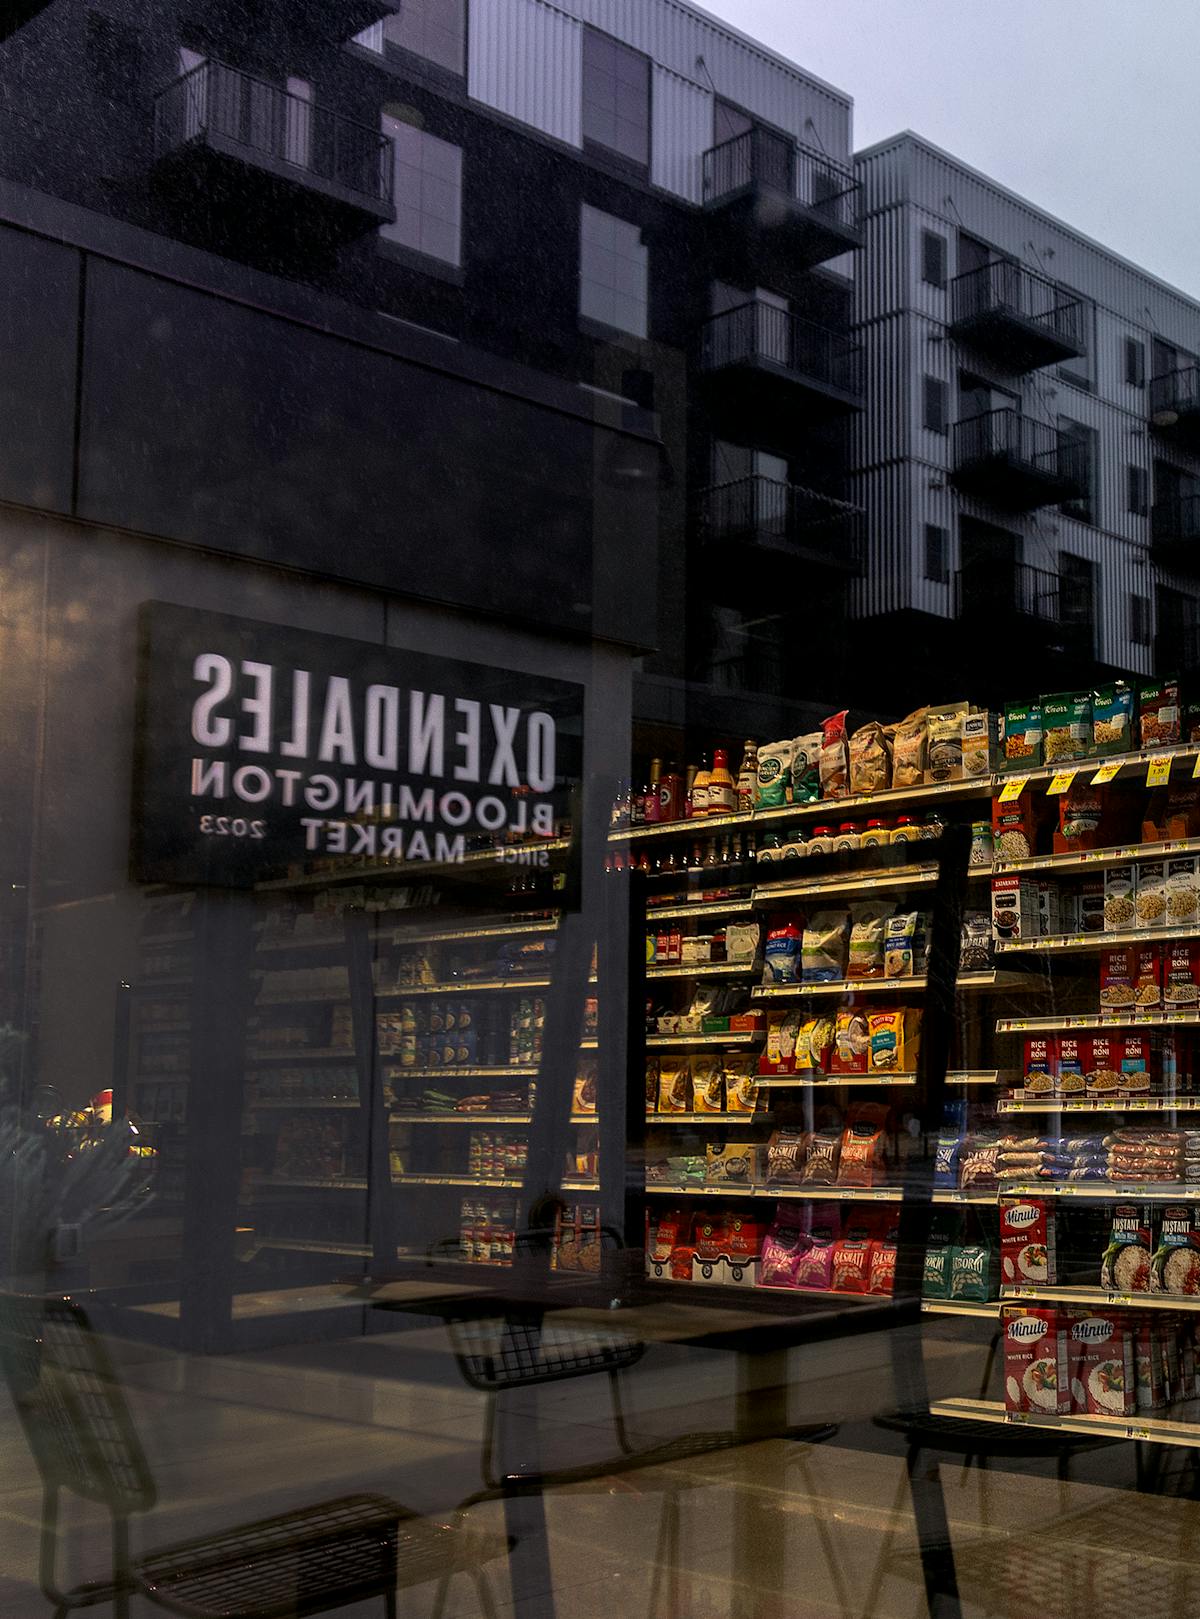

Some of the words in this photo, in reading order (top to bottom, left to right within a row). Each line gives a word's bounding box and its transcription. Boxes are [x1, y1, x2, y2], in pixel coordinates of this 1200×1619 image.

[1004, 1206, 1041, 1226] Minute
[1112, 1219, 1140, 1232] INSTANT
[1162, 1220, 1191, 1233] INSTANT
[1007, 1321, 1048, 1340] Minute
[1071, 1322, 1114, 1341] Minute
